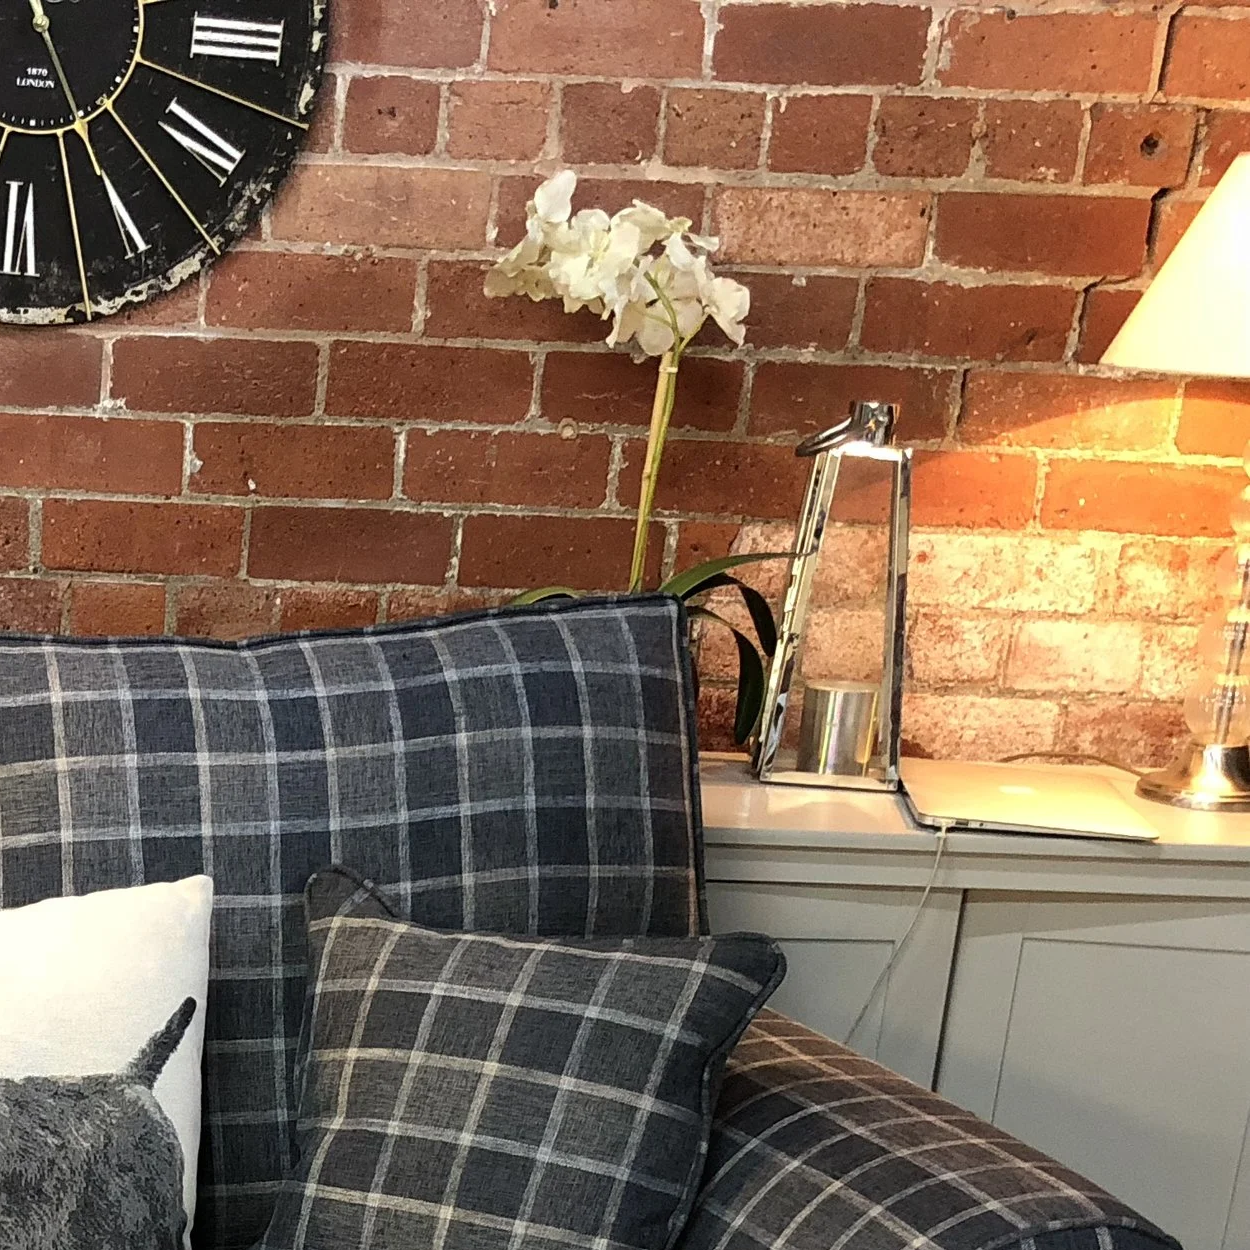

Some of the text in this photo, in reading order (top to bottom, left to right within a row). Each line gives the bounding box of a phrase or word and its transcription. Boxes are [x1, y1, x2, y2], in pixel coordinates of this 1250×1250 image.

[190, 11, 285, 67] III
[16, 77, 55, 89] LONDON
[158, 97, 246, 188] IV
[101, 169, 152, 259] V
